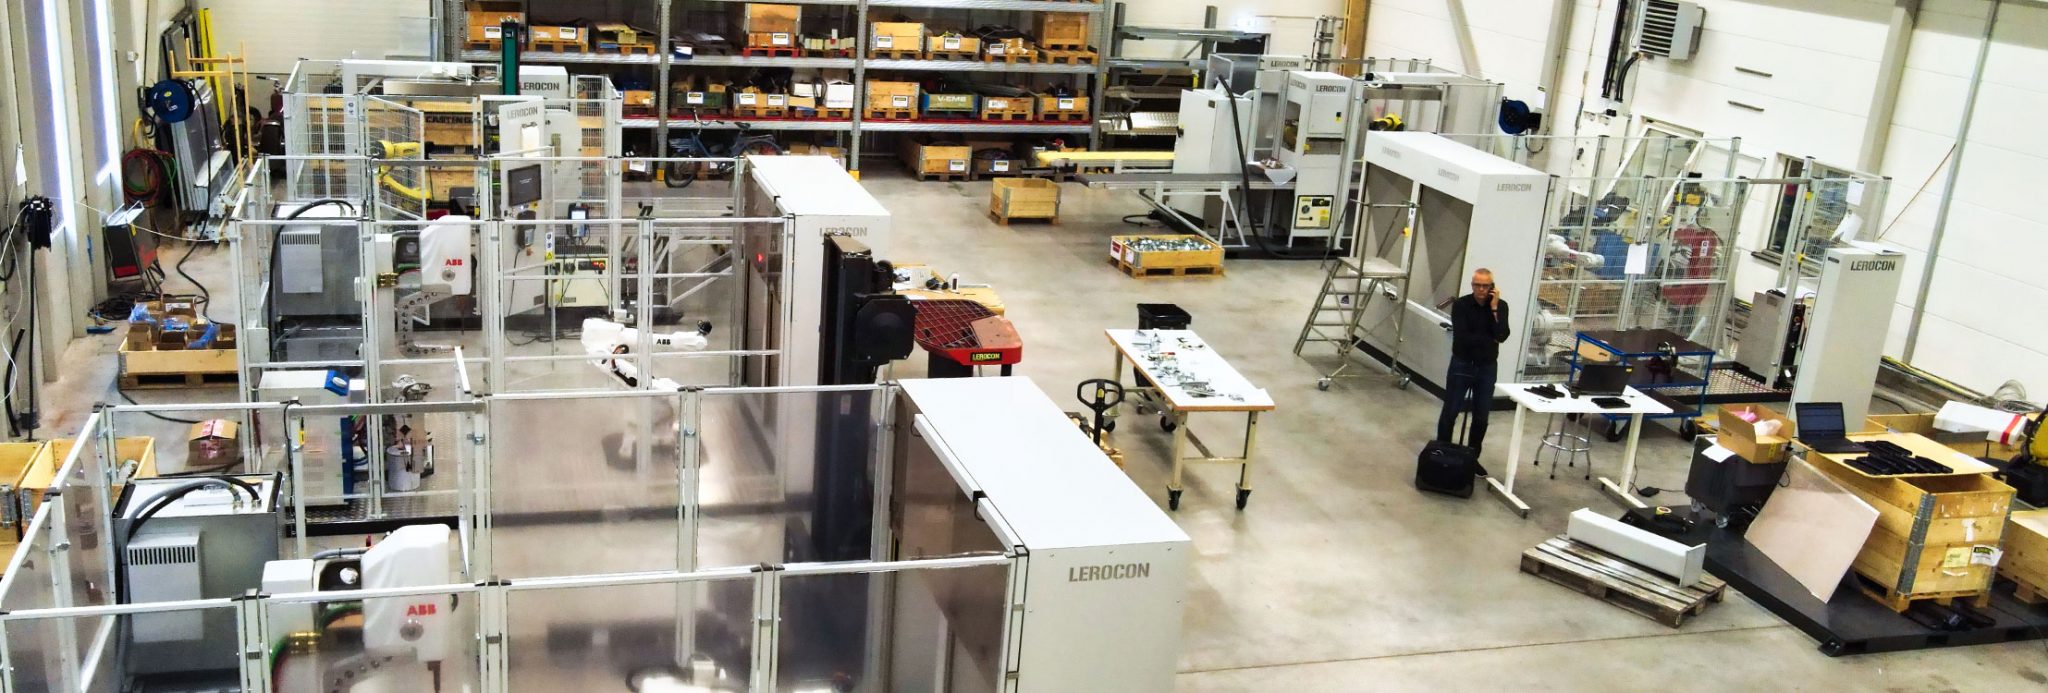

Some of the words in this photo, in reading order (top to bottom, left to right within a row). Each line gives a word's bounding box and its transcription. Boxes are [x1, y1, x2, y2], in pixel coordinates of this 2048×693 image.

[1315, 85, 1346, 93] LEROCON
[445, 258, 463, 266] ABB
[1850, 261, 1896, 271] LEROCON
[972, 353, 1000, 361] LEROCON
[1068, 563, 1150, 582] LEROCON
[407, 604, 436, 617] ABB
